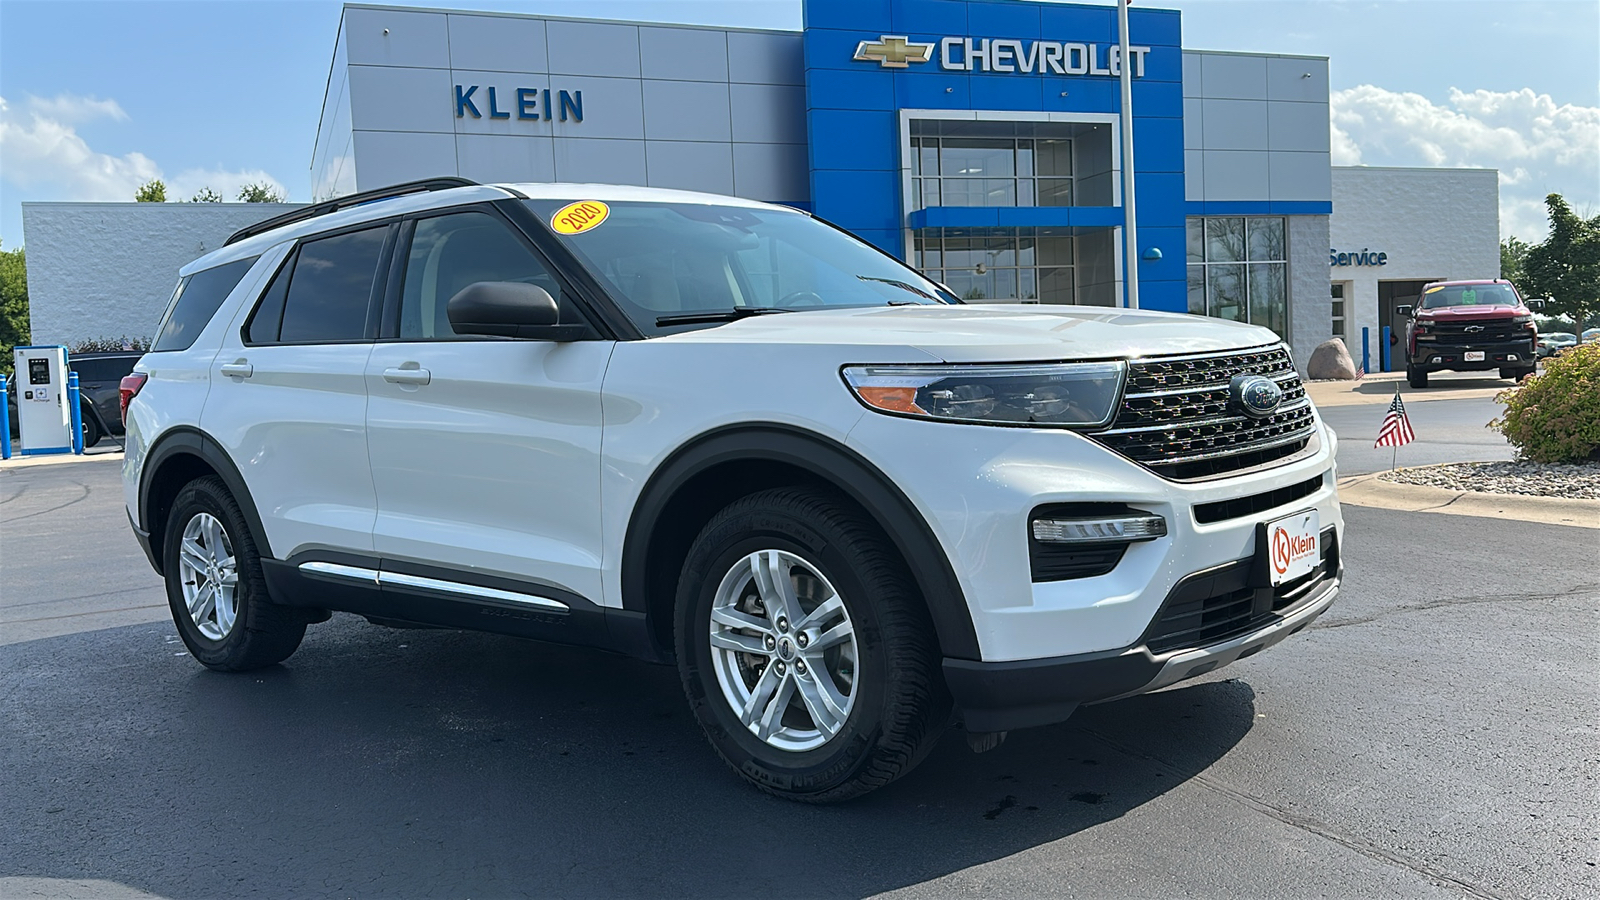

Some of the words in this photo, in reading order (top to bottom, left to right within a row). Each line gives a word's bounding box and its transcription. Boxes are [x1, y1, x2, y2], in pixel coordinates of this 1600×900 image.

[454, 84, 584, 122] KLEIN
[560, 203, 601, 230] 2020
[1330, 247, 1388, 266] Service
[1291, 533, 1316, 557] Klein
